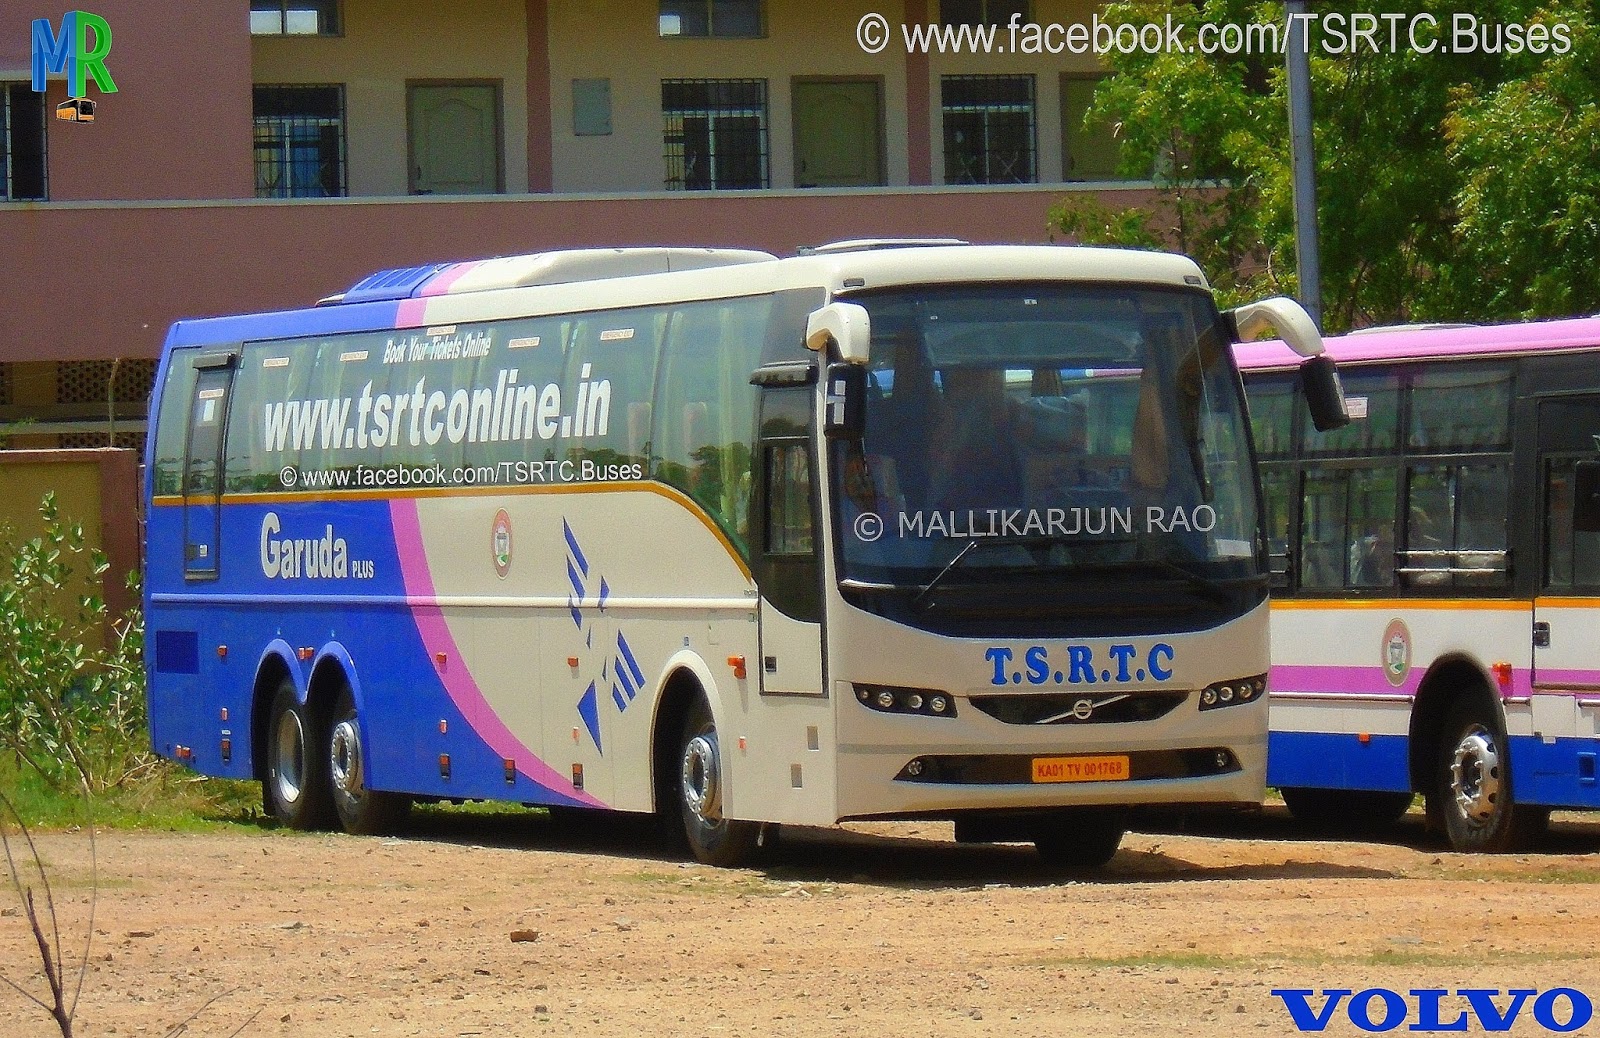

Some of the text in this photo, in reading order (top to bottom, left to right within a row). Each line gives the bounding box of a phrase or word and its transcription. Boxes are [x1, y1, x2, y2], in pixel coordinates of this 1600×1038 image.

[382, 331, 492, 364] Book Your Tickets Online
[264, 362, 611, 452] www.tsrtconline.in
[260, 511, 375, 579] Garuda PLUS
[985, 643, 1175, 685] T.S.R.T.C
[1037, 761, 1122, 777] KA01 TV 001768
